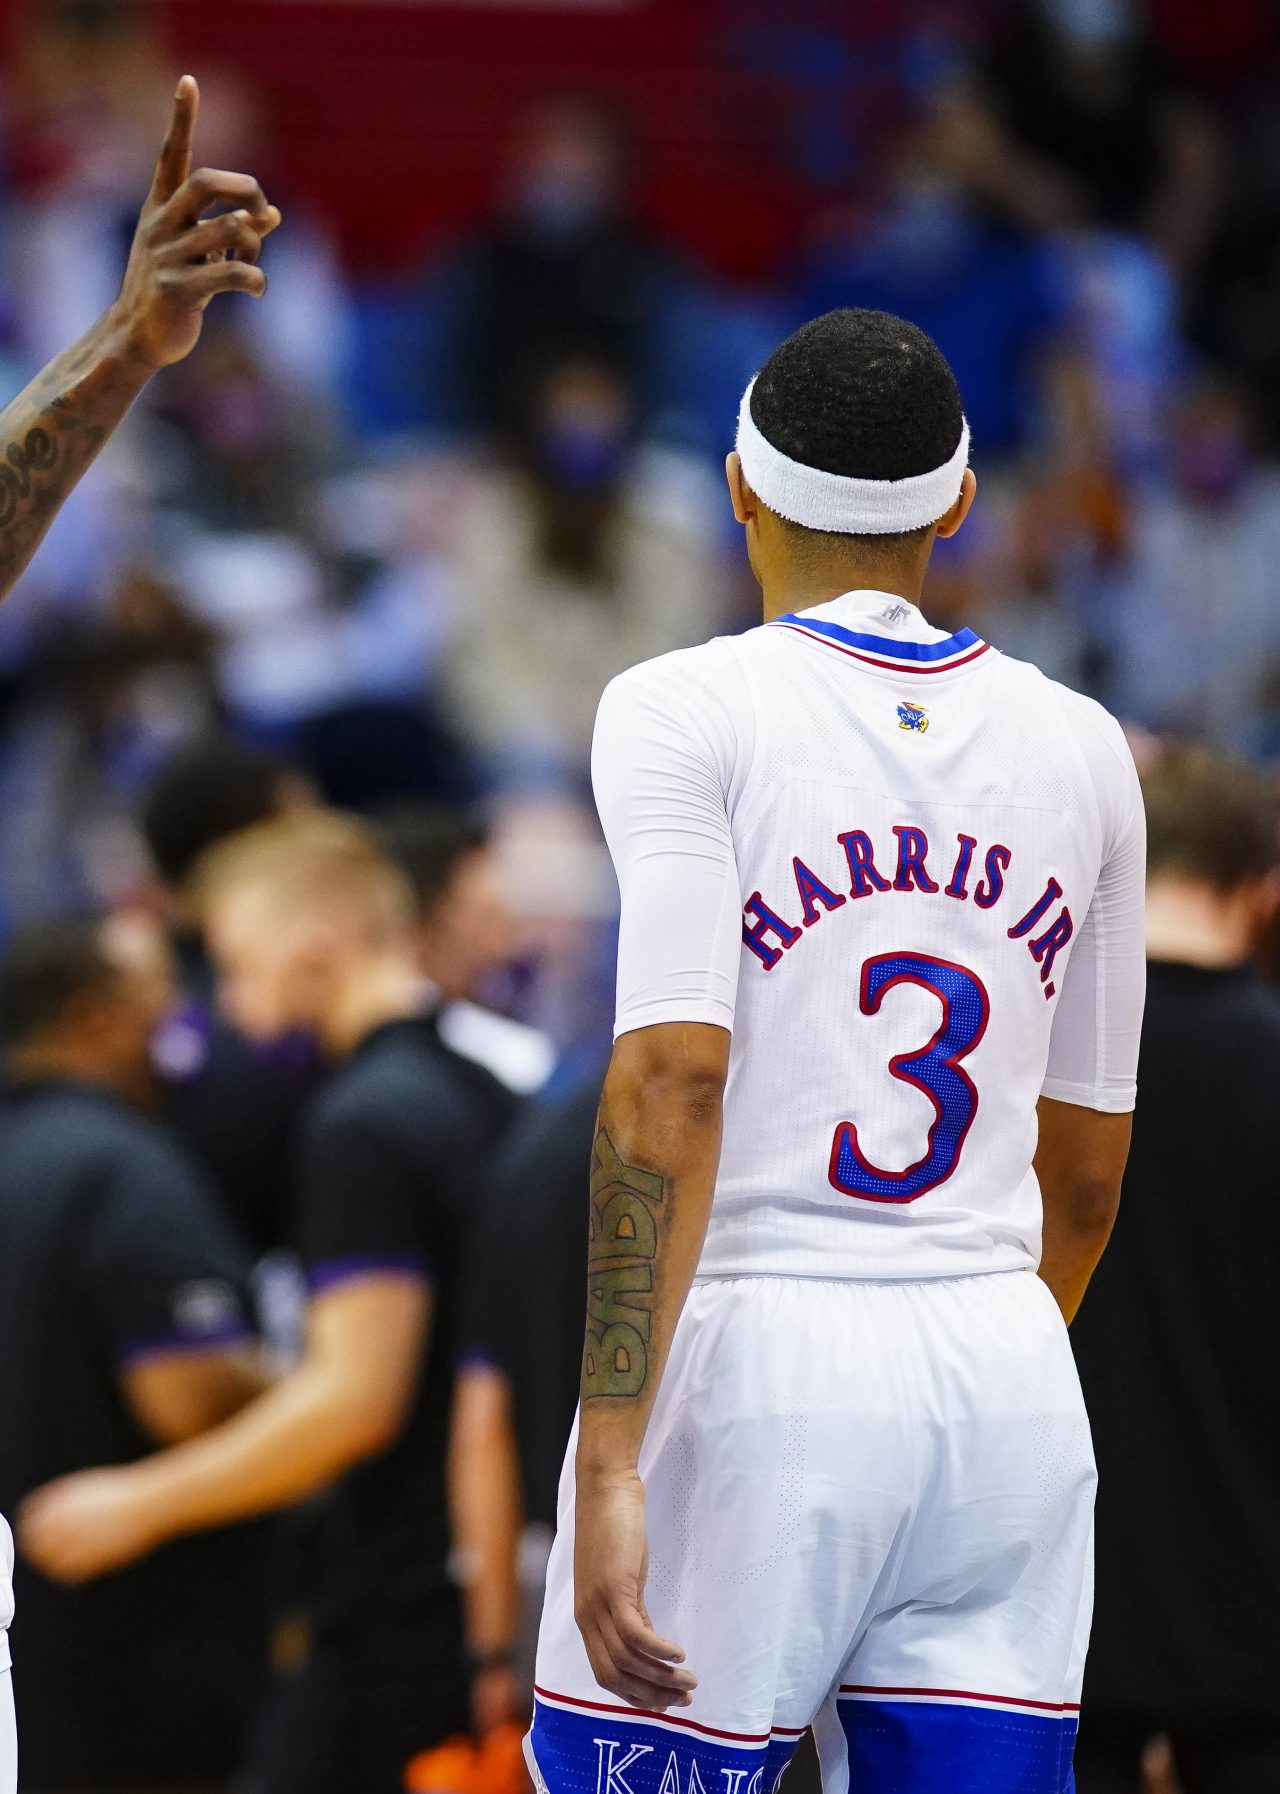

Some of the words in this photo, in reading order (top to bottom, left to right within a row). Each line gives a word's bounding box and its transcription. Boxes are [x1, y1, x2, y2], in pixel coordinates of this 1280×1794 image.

[742, 826, 1012, 971] HARRIS
[1007, 876, 1074, 1000] JR.
[828, 951, 990, 1204] 3
